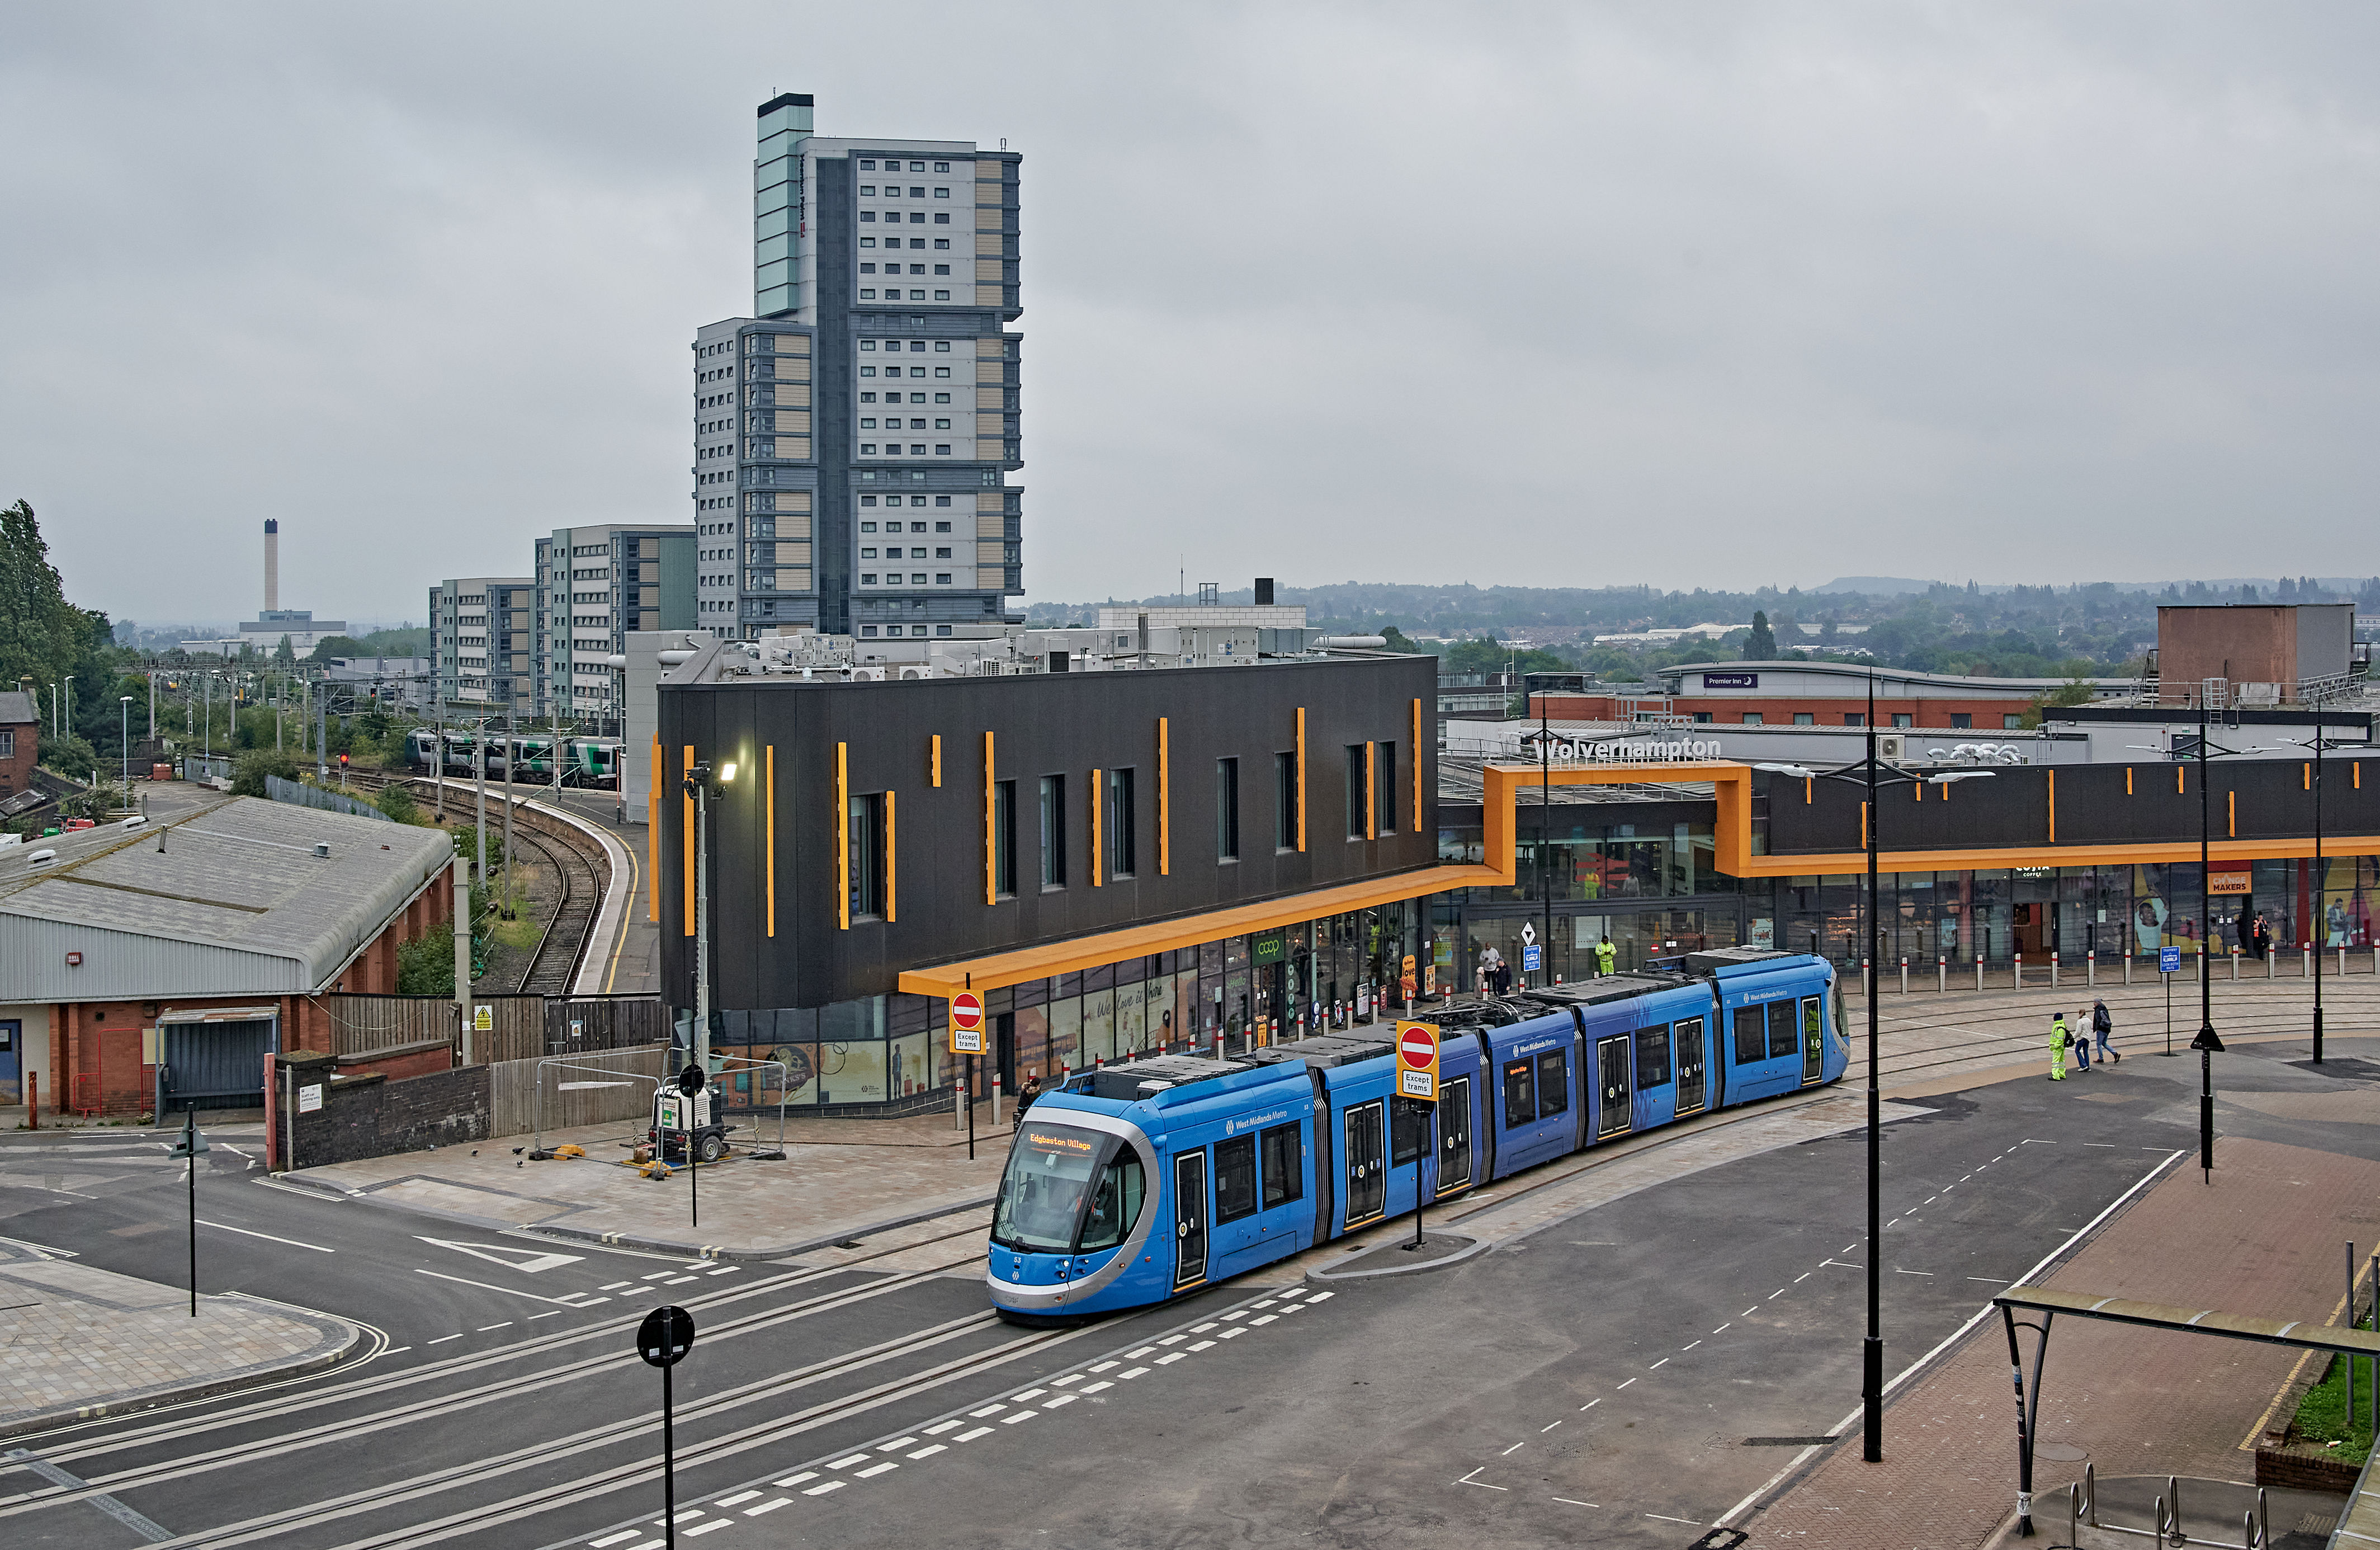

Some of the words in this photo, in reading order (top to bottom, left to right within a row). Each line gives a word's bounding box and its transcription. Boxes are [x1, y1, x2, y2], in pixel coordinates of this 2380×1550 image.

[1533, 737, 1721, 761] Wolverhampton
[2213, 874, 2246, 884] CHANGE
[1403, 967, 1415, 977] love
[1097, 999, 1112, 1017] We
[1117, 994, 1134, 1010] love
[1136, 990, 1143, 1004] it
[1529, 1040, 1545, 1050] Midlands
[1406, 1074, 1429, 1083] Except
[1408, 1083, 1427, 1091] trams
[1236, 1121, 1249, 1129] West
[1249, 1113, 1272, 1126] Midlands
[1272, 1110, 1287, 1119] Metro
[1030, 1133, 1066, 1146] Edgbaston
